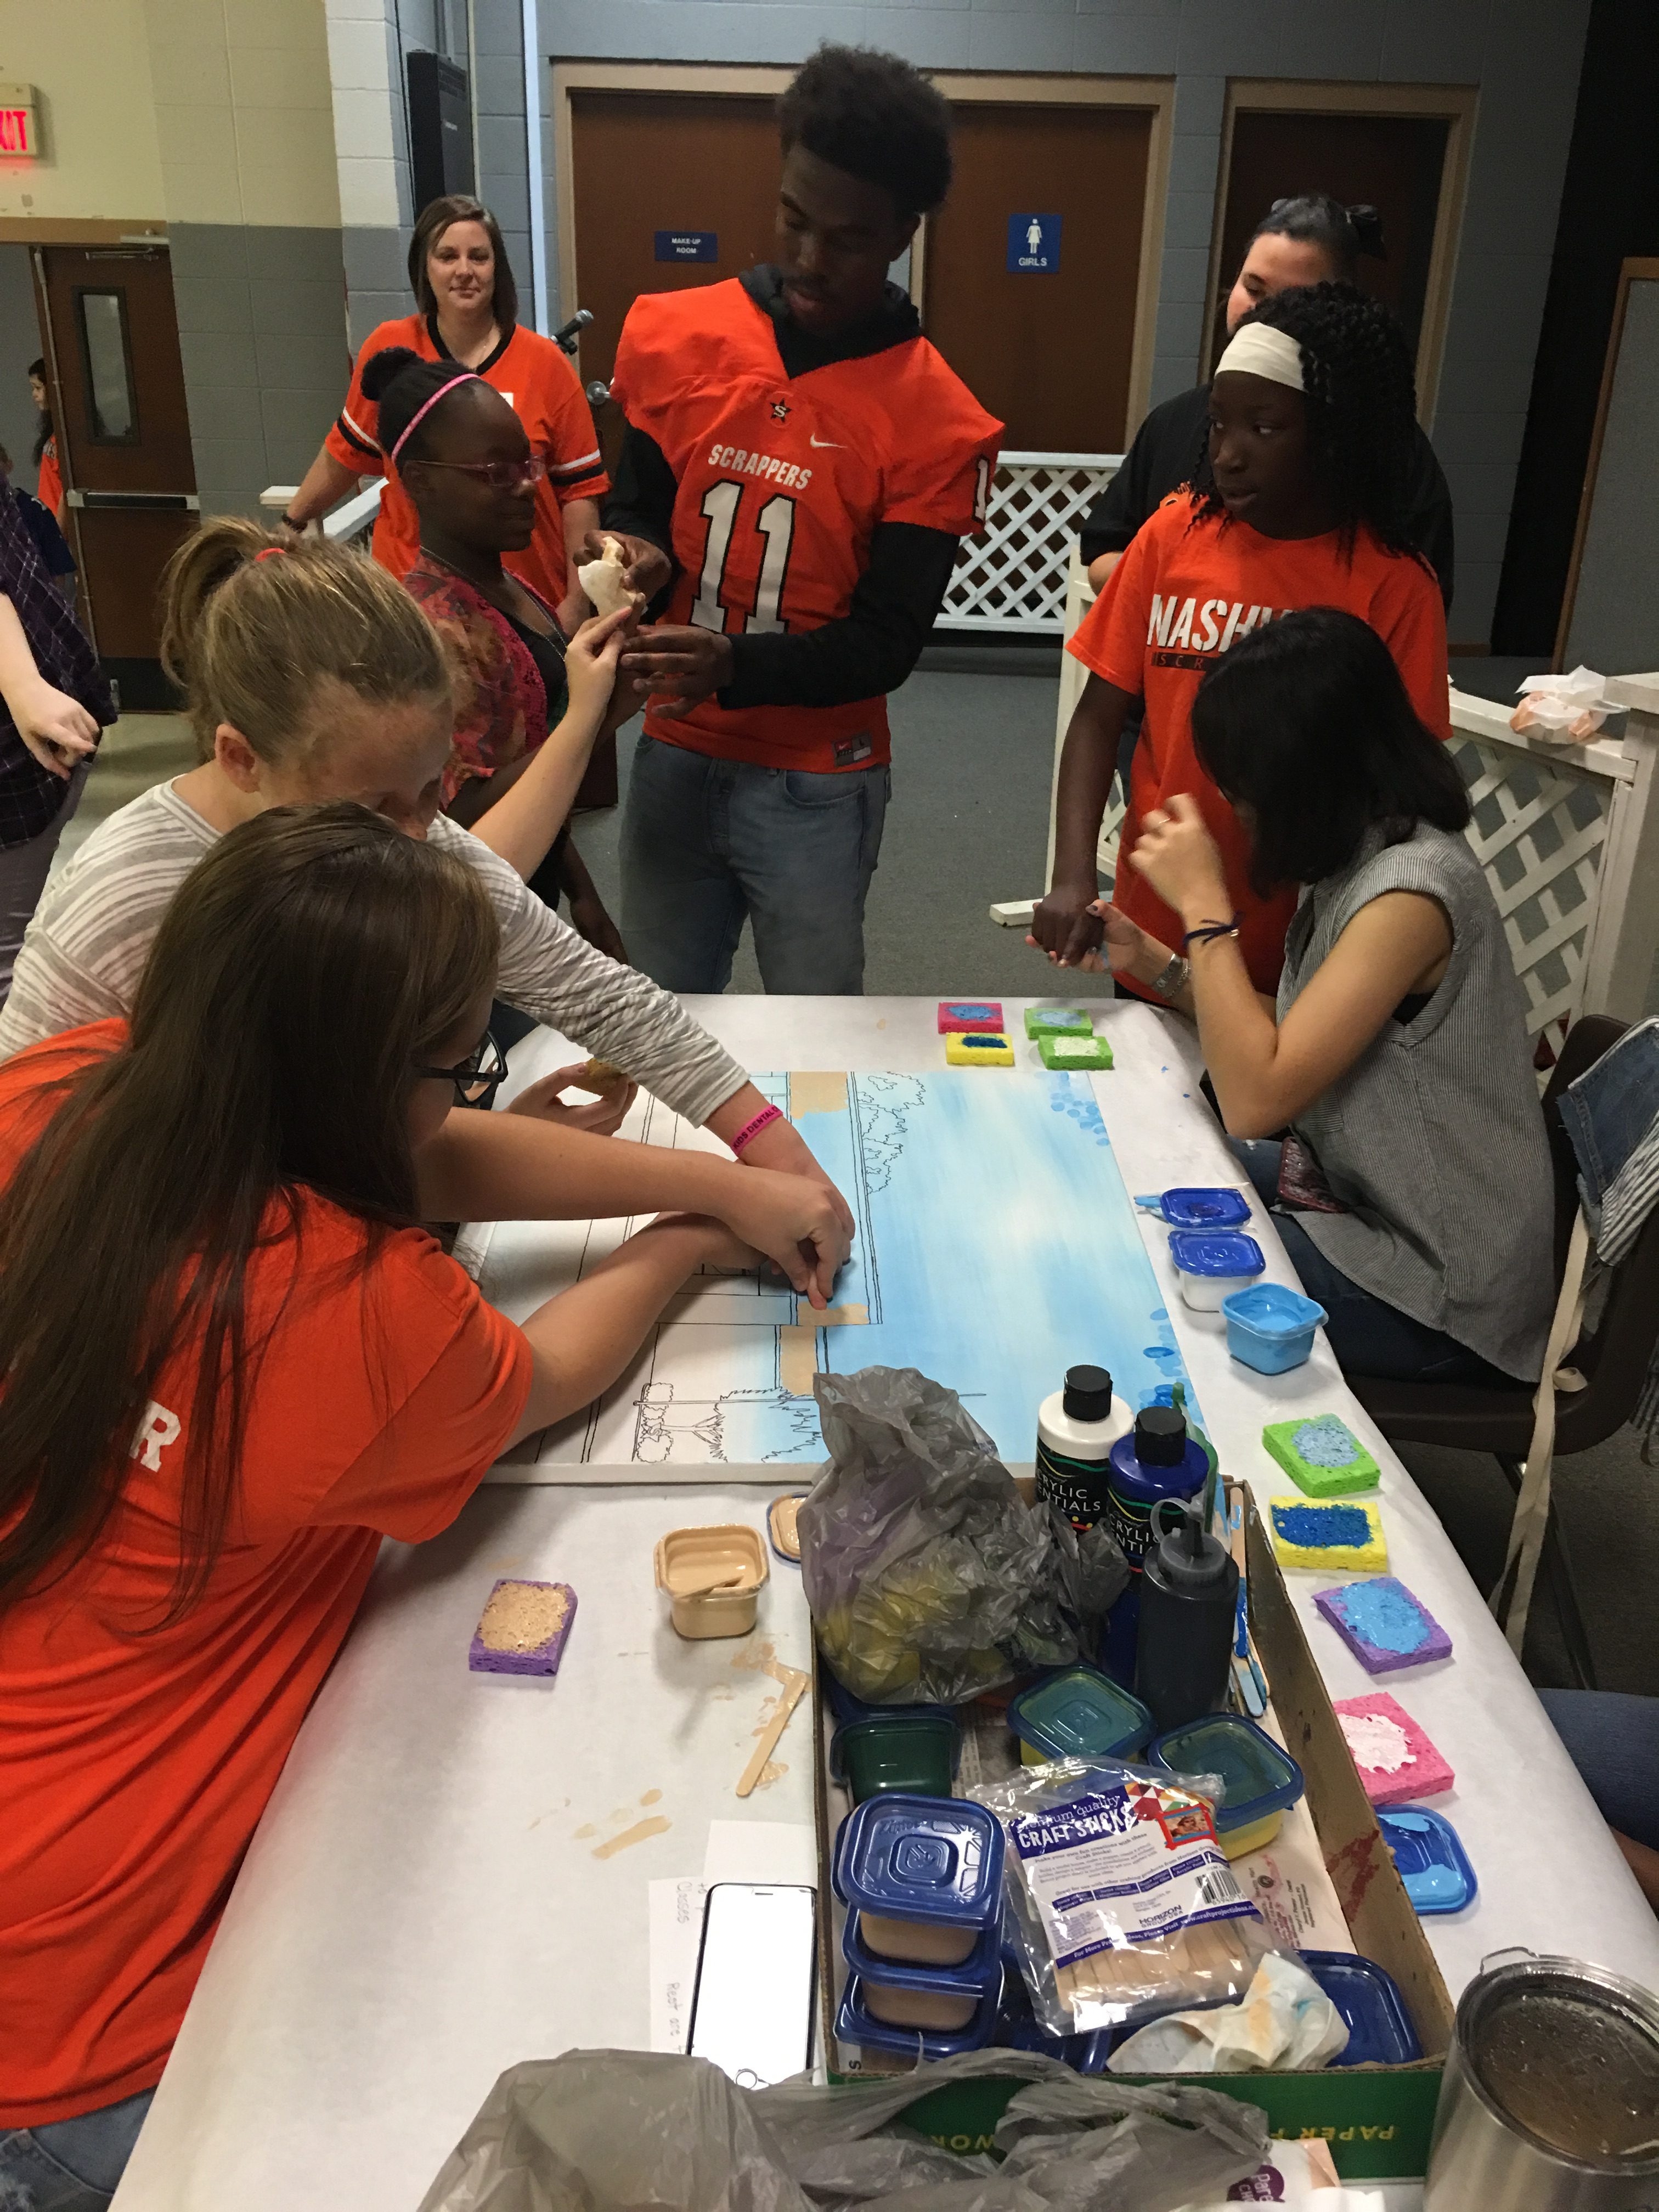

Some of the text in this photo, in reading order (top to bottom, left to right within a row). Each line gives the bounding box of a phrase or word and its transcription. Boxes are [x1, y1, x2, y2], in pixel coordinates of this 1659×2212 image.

[1018, 257, 1047, 267] GIRLS
[708, 444, 812, 490] SCRAPPERS
[690, 478, 797, 634] 11
[1146, 593, 1294, 653] NASH
[733, 1131, 748, 1149] KIDS
[747, 1110, 775, 1133] DENTAL
[129, 1399, 182, 1473] R
[1076, 1795, 1120, 1817] quality
[1018, 1825, 1070, 1848] CRAFT
[1139, 1905, 1182, 1924] HORIZON
[1074, 1950, 1084, 1958] For
[1085, 1944, 1101, 1954] More
[1164, 1921, 1178, 1932] Visit
[667, 1982, 681, 2012] Rest
[1300, 2125, 1395, 2141] PAPER
